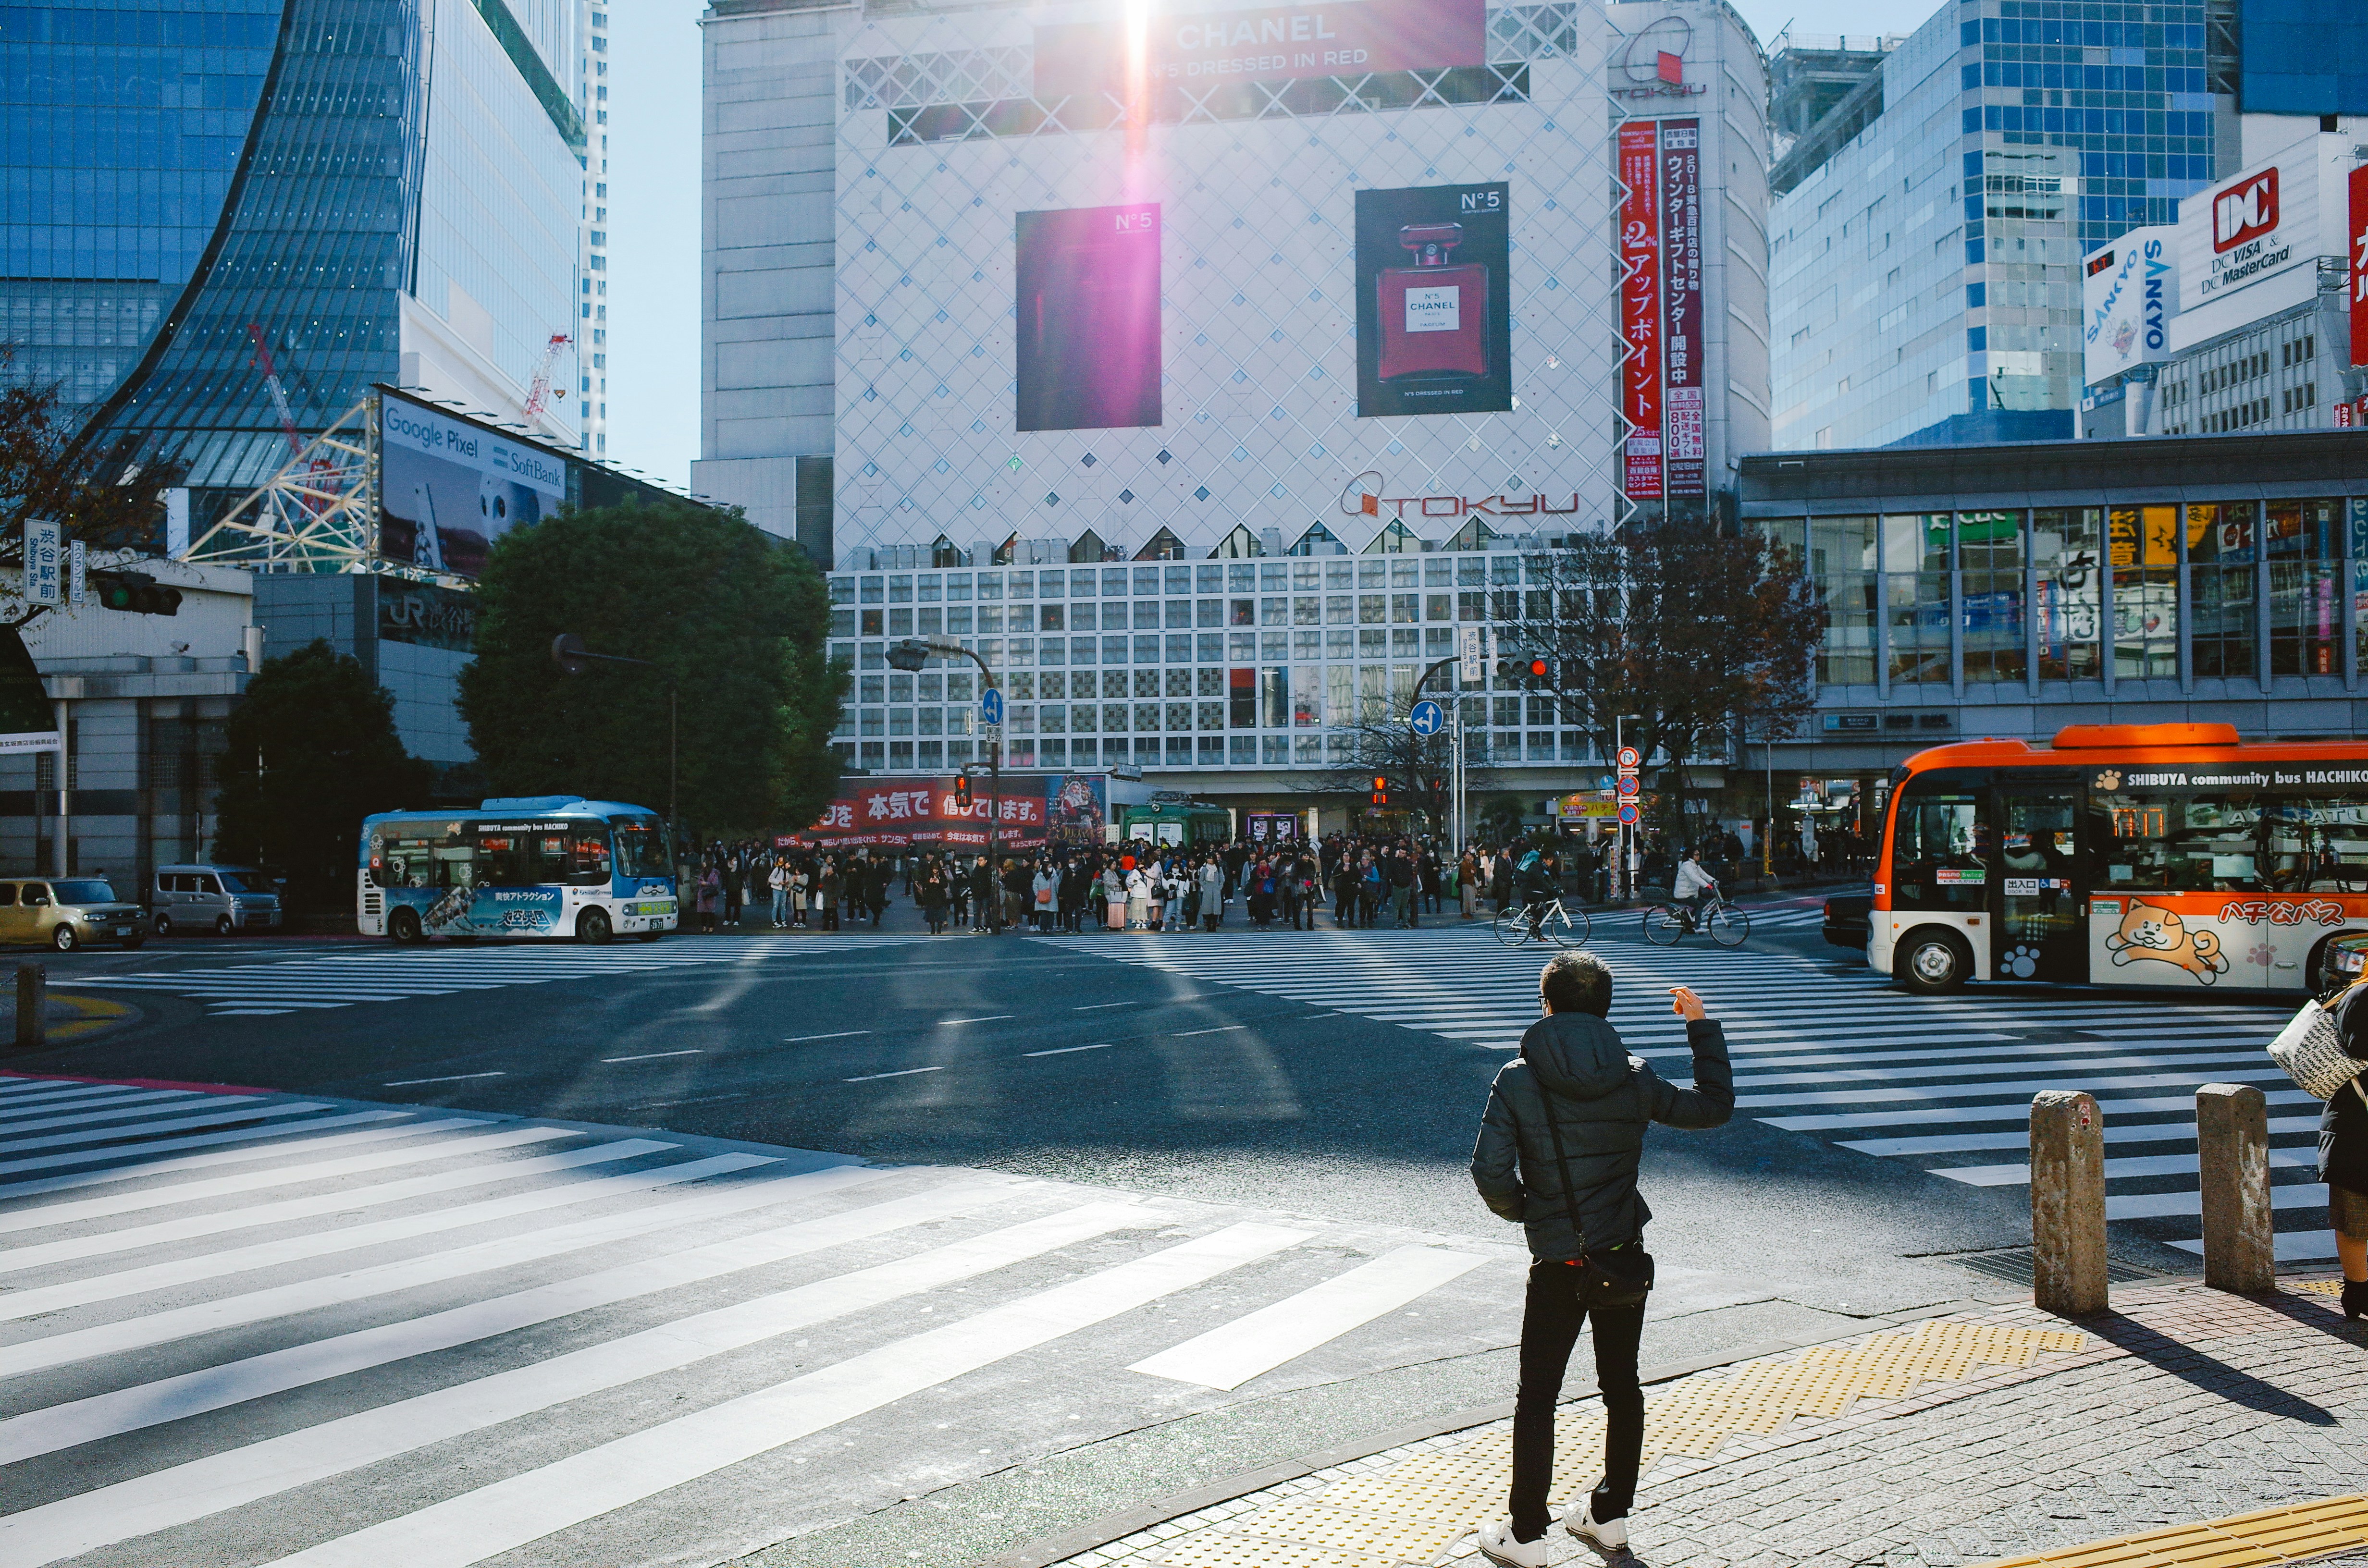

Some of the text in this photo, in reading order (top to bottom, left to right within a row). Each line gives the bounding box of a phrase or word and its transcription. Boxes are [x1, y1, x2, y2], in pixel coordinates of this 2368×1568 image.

[1176, 14, 1336, 50] CHANEL
[1187, 54, 1287, 77] DRESSED
[1294, 53, 1316, 68] IN
[1323, 49, 1368, 66] RED
[1611, 84, 1706, 100] TOKYU
[2218, 177, 2269, 244] DC
[2201, 245, 2291, 294] DC MasterCard
[2211, 235, 2280, 274] DC VISA &
[1411, 301, 1455, 310] CHANEL
[2086, 249, 2137, 344] SANKYO
[2145, 240, 2171, 350] SANKYO
[386, 407, 561, 487] Google Pixel SoftBank
[1381, 492, 1579, 517] TOKYU
[29, 538, 38, 588] Shibuya Sta.
[40, 529, 55, 599] 渋谷駅前
[74, 544, 82, 600] スクランブル式
[391, 596, 423, 628] JR
[1468, 632, 1478, 676] 渋谷駅前
[2127, 770, 2368, 787] SHIBUYA community bus HACHIKO
[868, 791, 930, 820] 本気で
[502, 823, 532, 833] community
[881, 834, 907, 845] サンタに
[946, 832, 985, 843] 今年は本気で
[495, 892, 555, 901] 爽快アトラクション
[2008, 880, 2036, 889] 出入口
[2219, 899, 2345, 926] ハチ公バス
